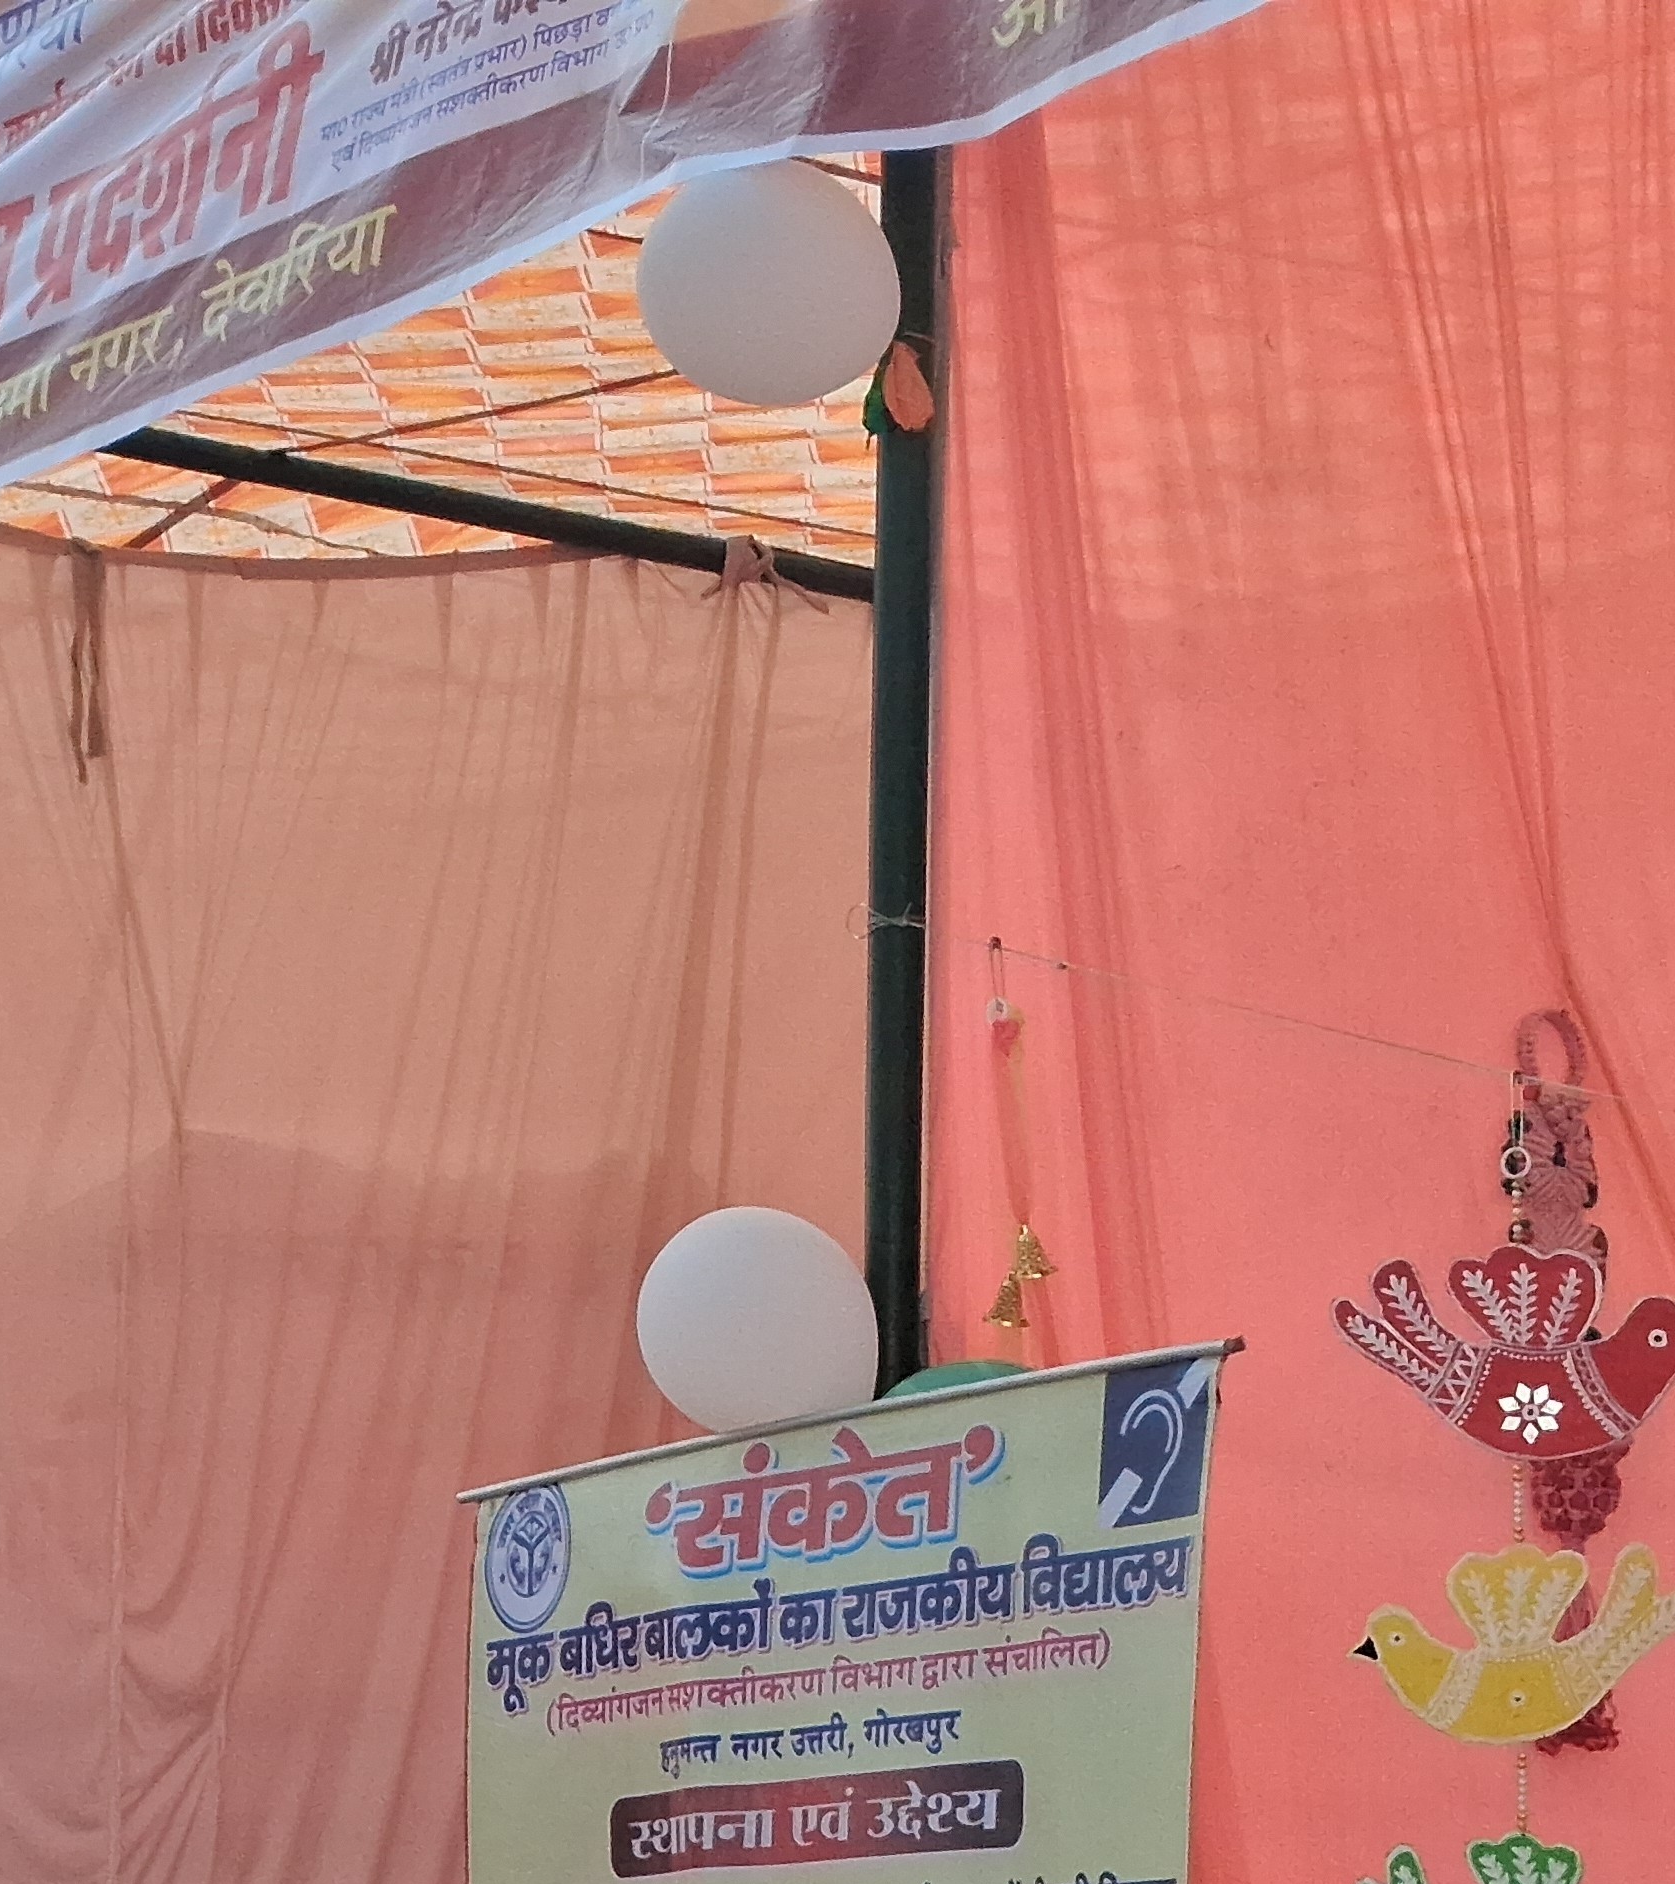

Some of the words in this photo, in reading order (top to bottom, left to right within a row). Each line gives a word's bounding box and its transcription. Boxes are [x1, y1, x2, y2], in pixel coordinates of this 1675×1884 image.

[370, 19, 410, 85] श्री
[550, 38, 611, 79] विभाग
[201, 204, 398, 342] देवरिया
[487, 1633, 555, 1717] मूक
[559, 1601, 641, 1678] बधिर
[643, 1578, 776, 1662] बालकों
[779, 1588, 840, 1646] का
[842, 1546, 1017, 1643] राजकीय
[1021, 1533, 1194, 1615] विद्यालय
[667, 1666, 827, 1714] सशक्तीकरण
[832, 1654, 917, 1696] विभाग
[920, 1649, 979, 1691] द्वारा
[983, 1627, 1111, 1678] संचालित)
[730, 1730, 784, 1762] नगर
[790, 1711, 856, 1760] उत्तरी,
[863, 1708, 963, 1755] गोरखपुर
[628, 1808, 776, 1861] स्थापना
[789, 1787, 855, 1848] एवं
[866, 1780, 1003, 1841] उद्देश्य
